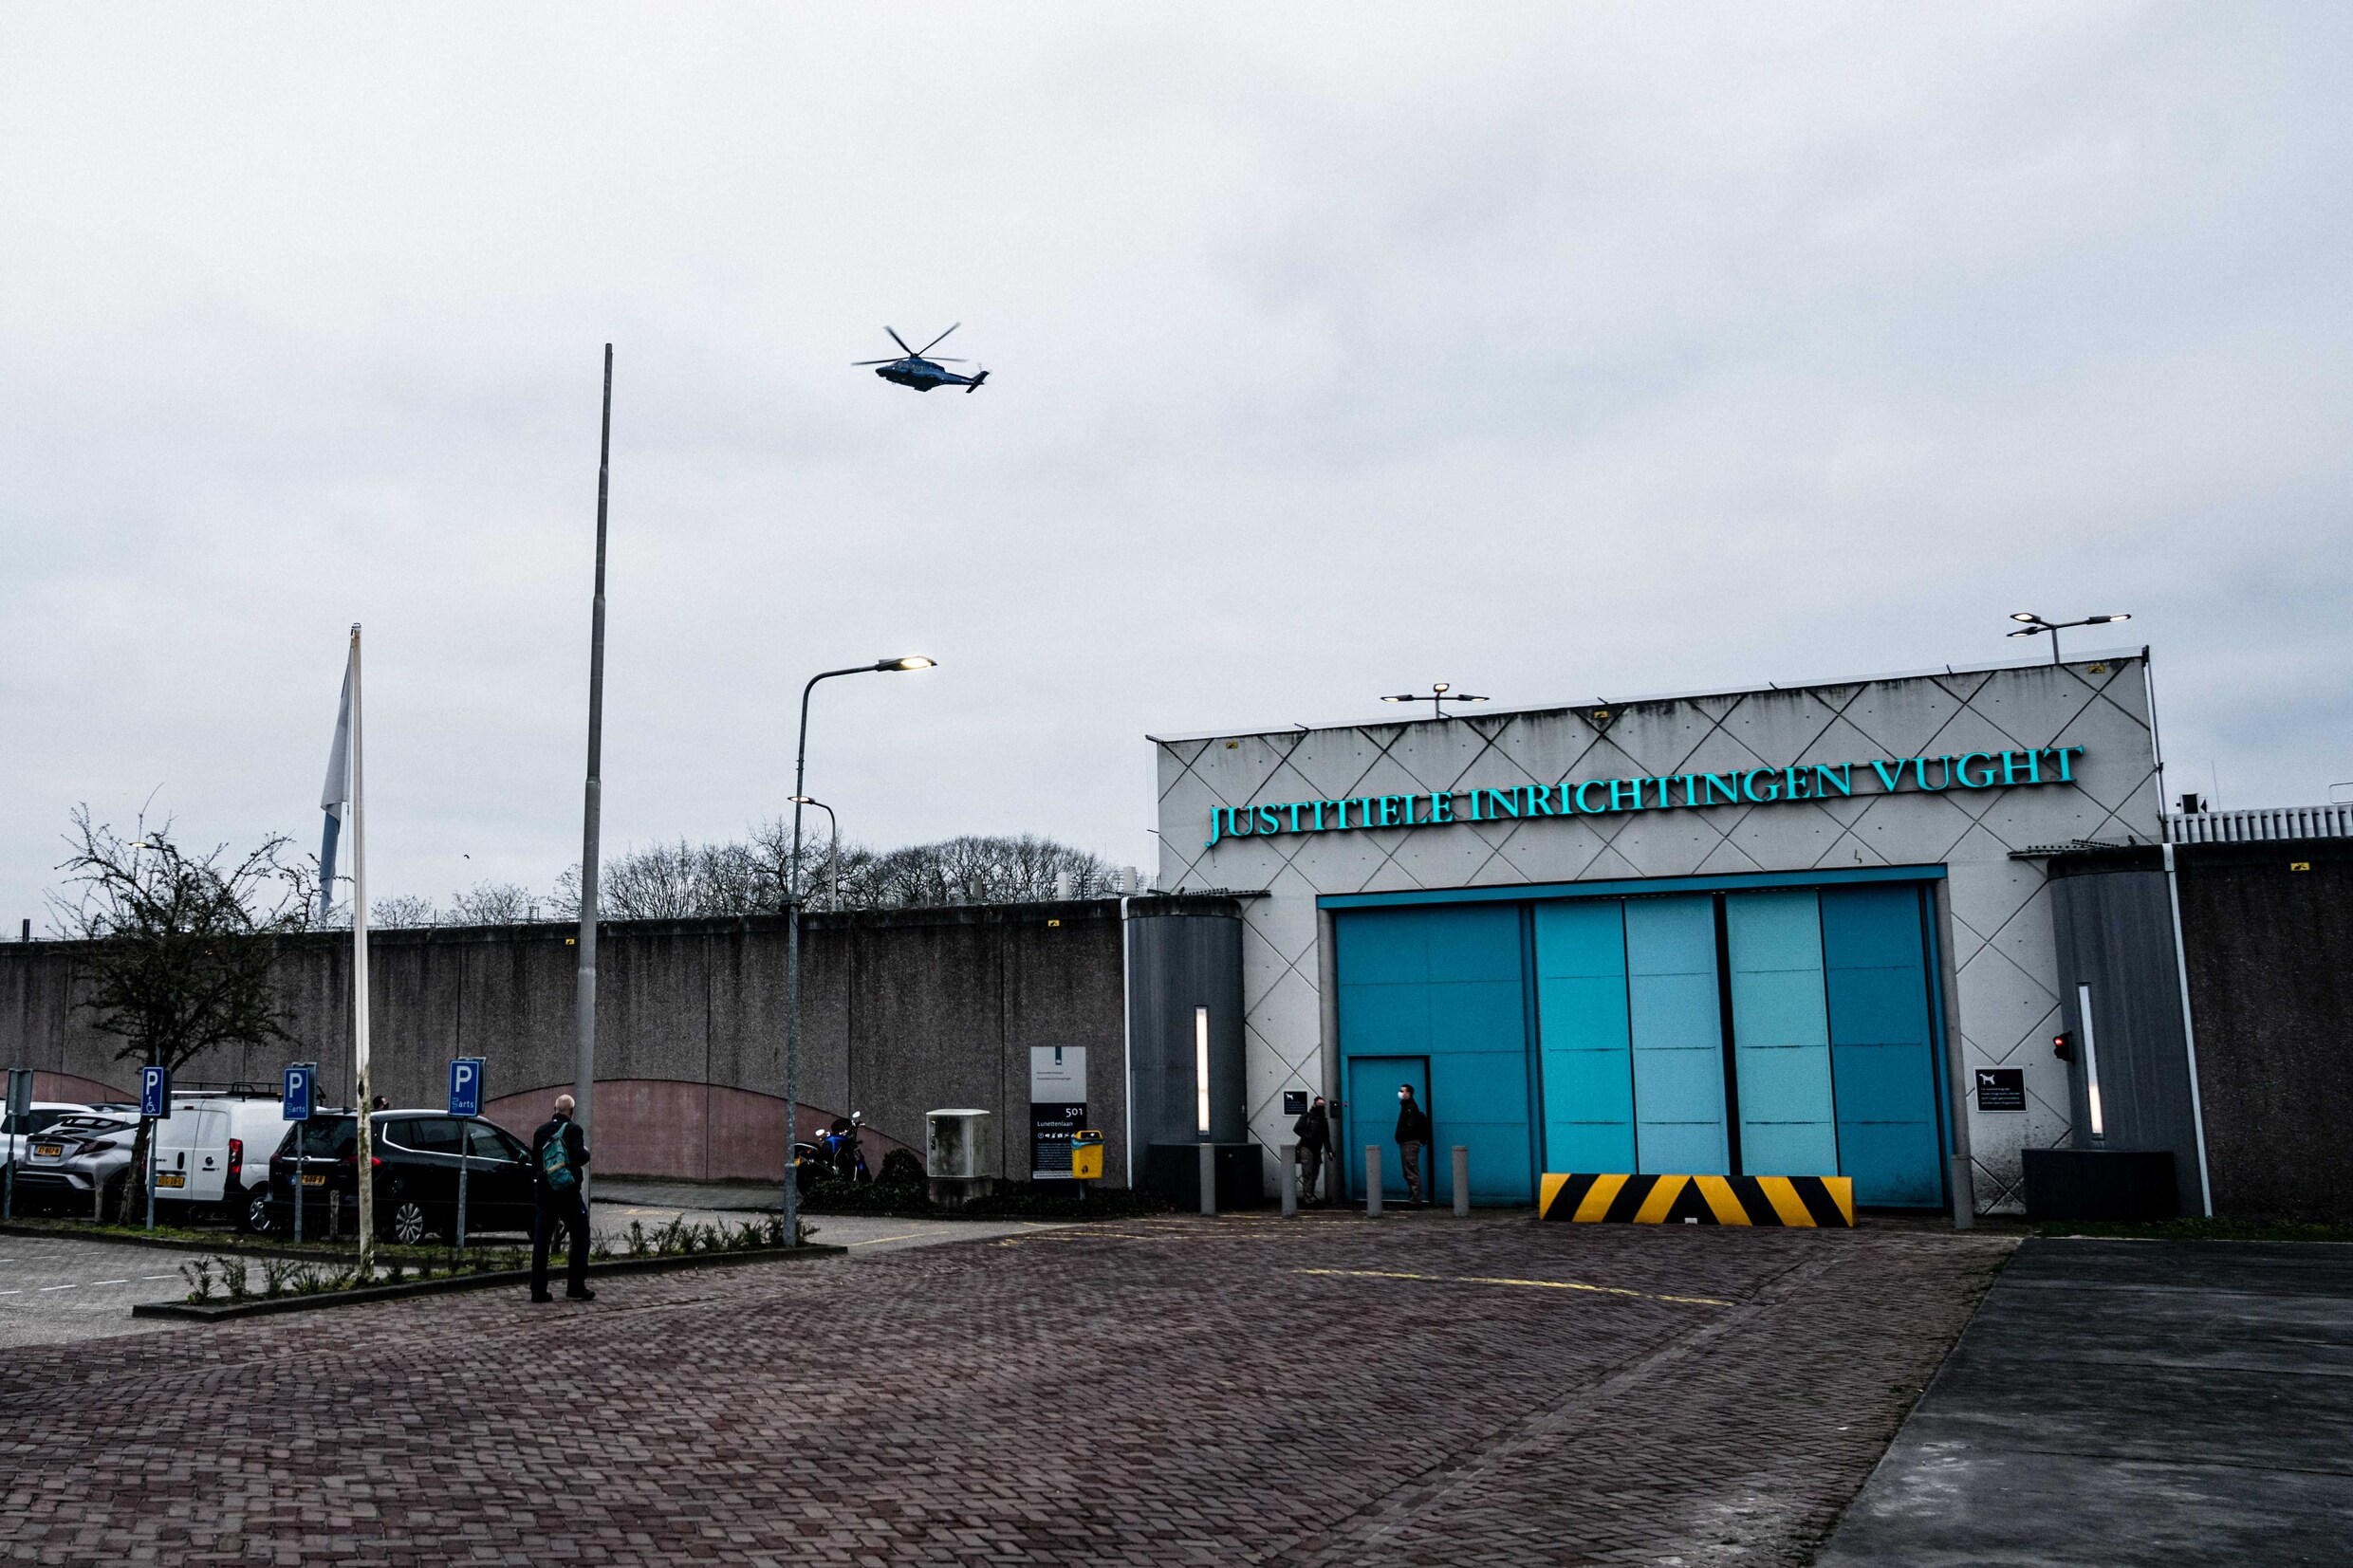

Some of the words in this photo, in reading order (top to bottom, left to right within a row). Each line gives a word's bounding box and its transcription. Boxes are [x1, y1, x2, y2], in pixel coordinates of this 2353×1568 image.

[1204, 789, 1454, 849] JUSTITIELE
[1469, 762, 1853, 821] INRICHTINGEN
[1869, 745, 2085, 791] VUGHT
[145, 1070, 158, 1096] P
[288, 1072, 303, 1098] P
[455, 1064, 472, 1093] P
[1065, 1108, 1083, 1117] 501
